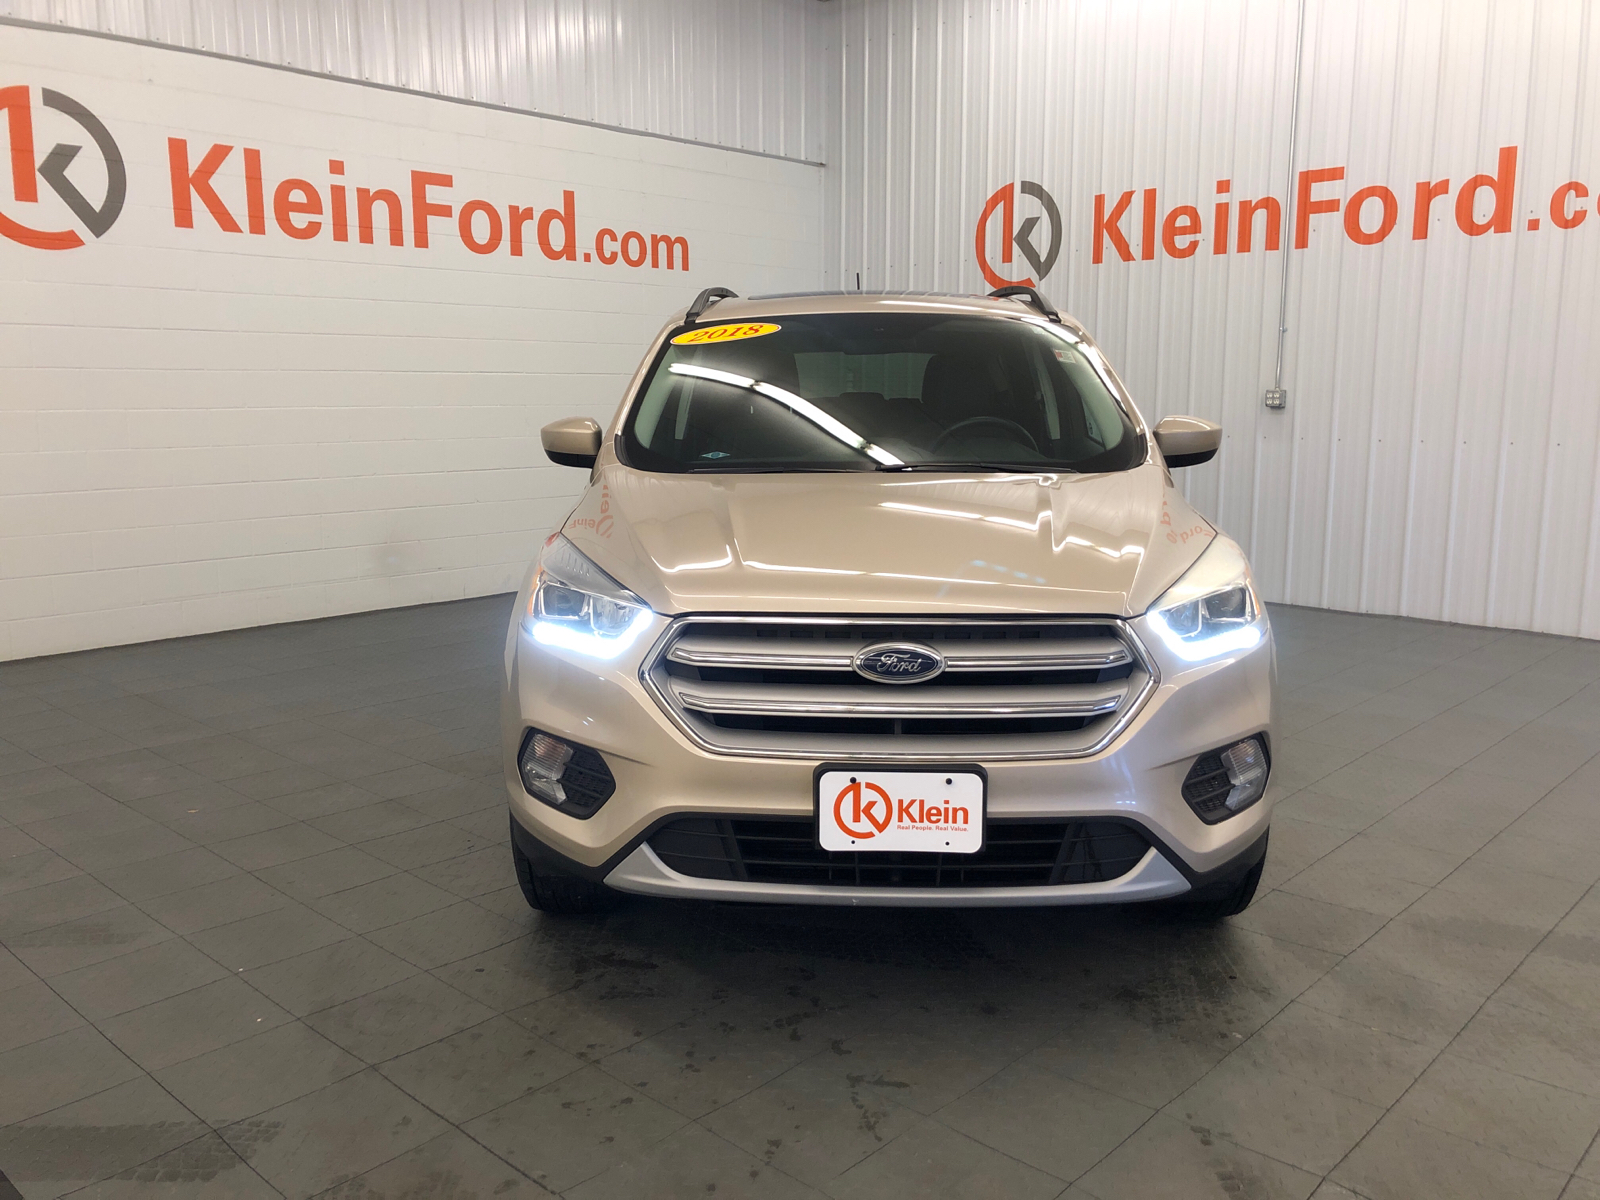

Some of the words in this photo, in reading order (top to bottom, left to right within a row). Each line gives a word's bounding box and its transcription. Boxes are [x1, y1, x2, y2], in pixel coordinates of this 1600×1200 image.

[167, 136, 690, 272] KleinFord.com
[1091, 145, 1600, 265] KleinFord.c
[687, 324, 764, 343] 2018
[876, 652, 922, 672] Ford
[897, 798, 969, 825] Klein
